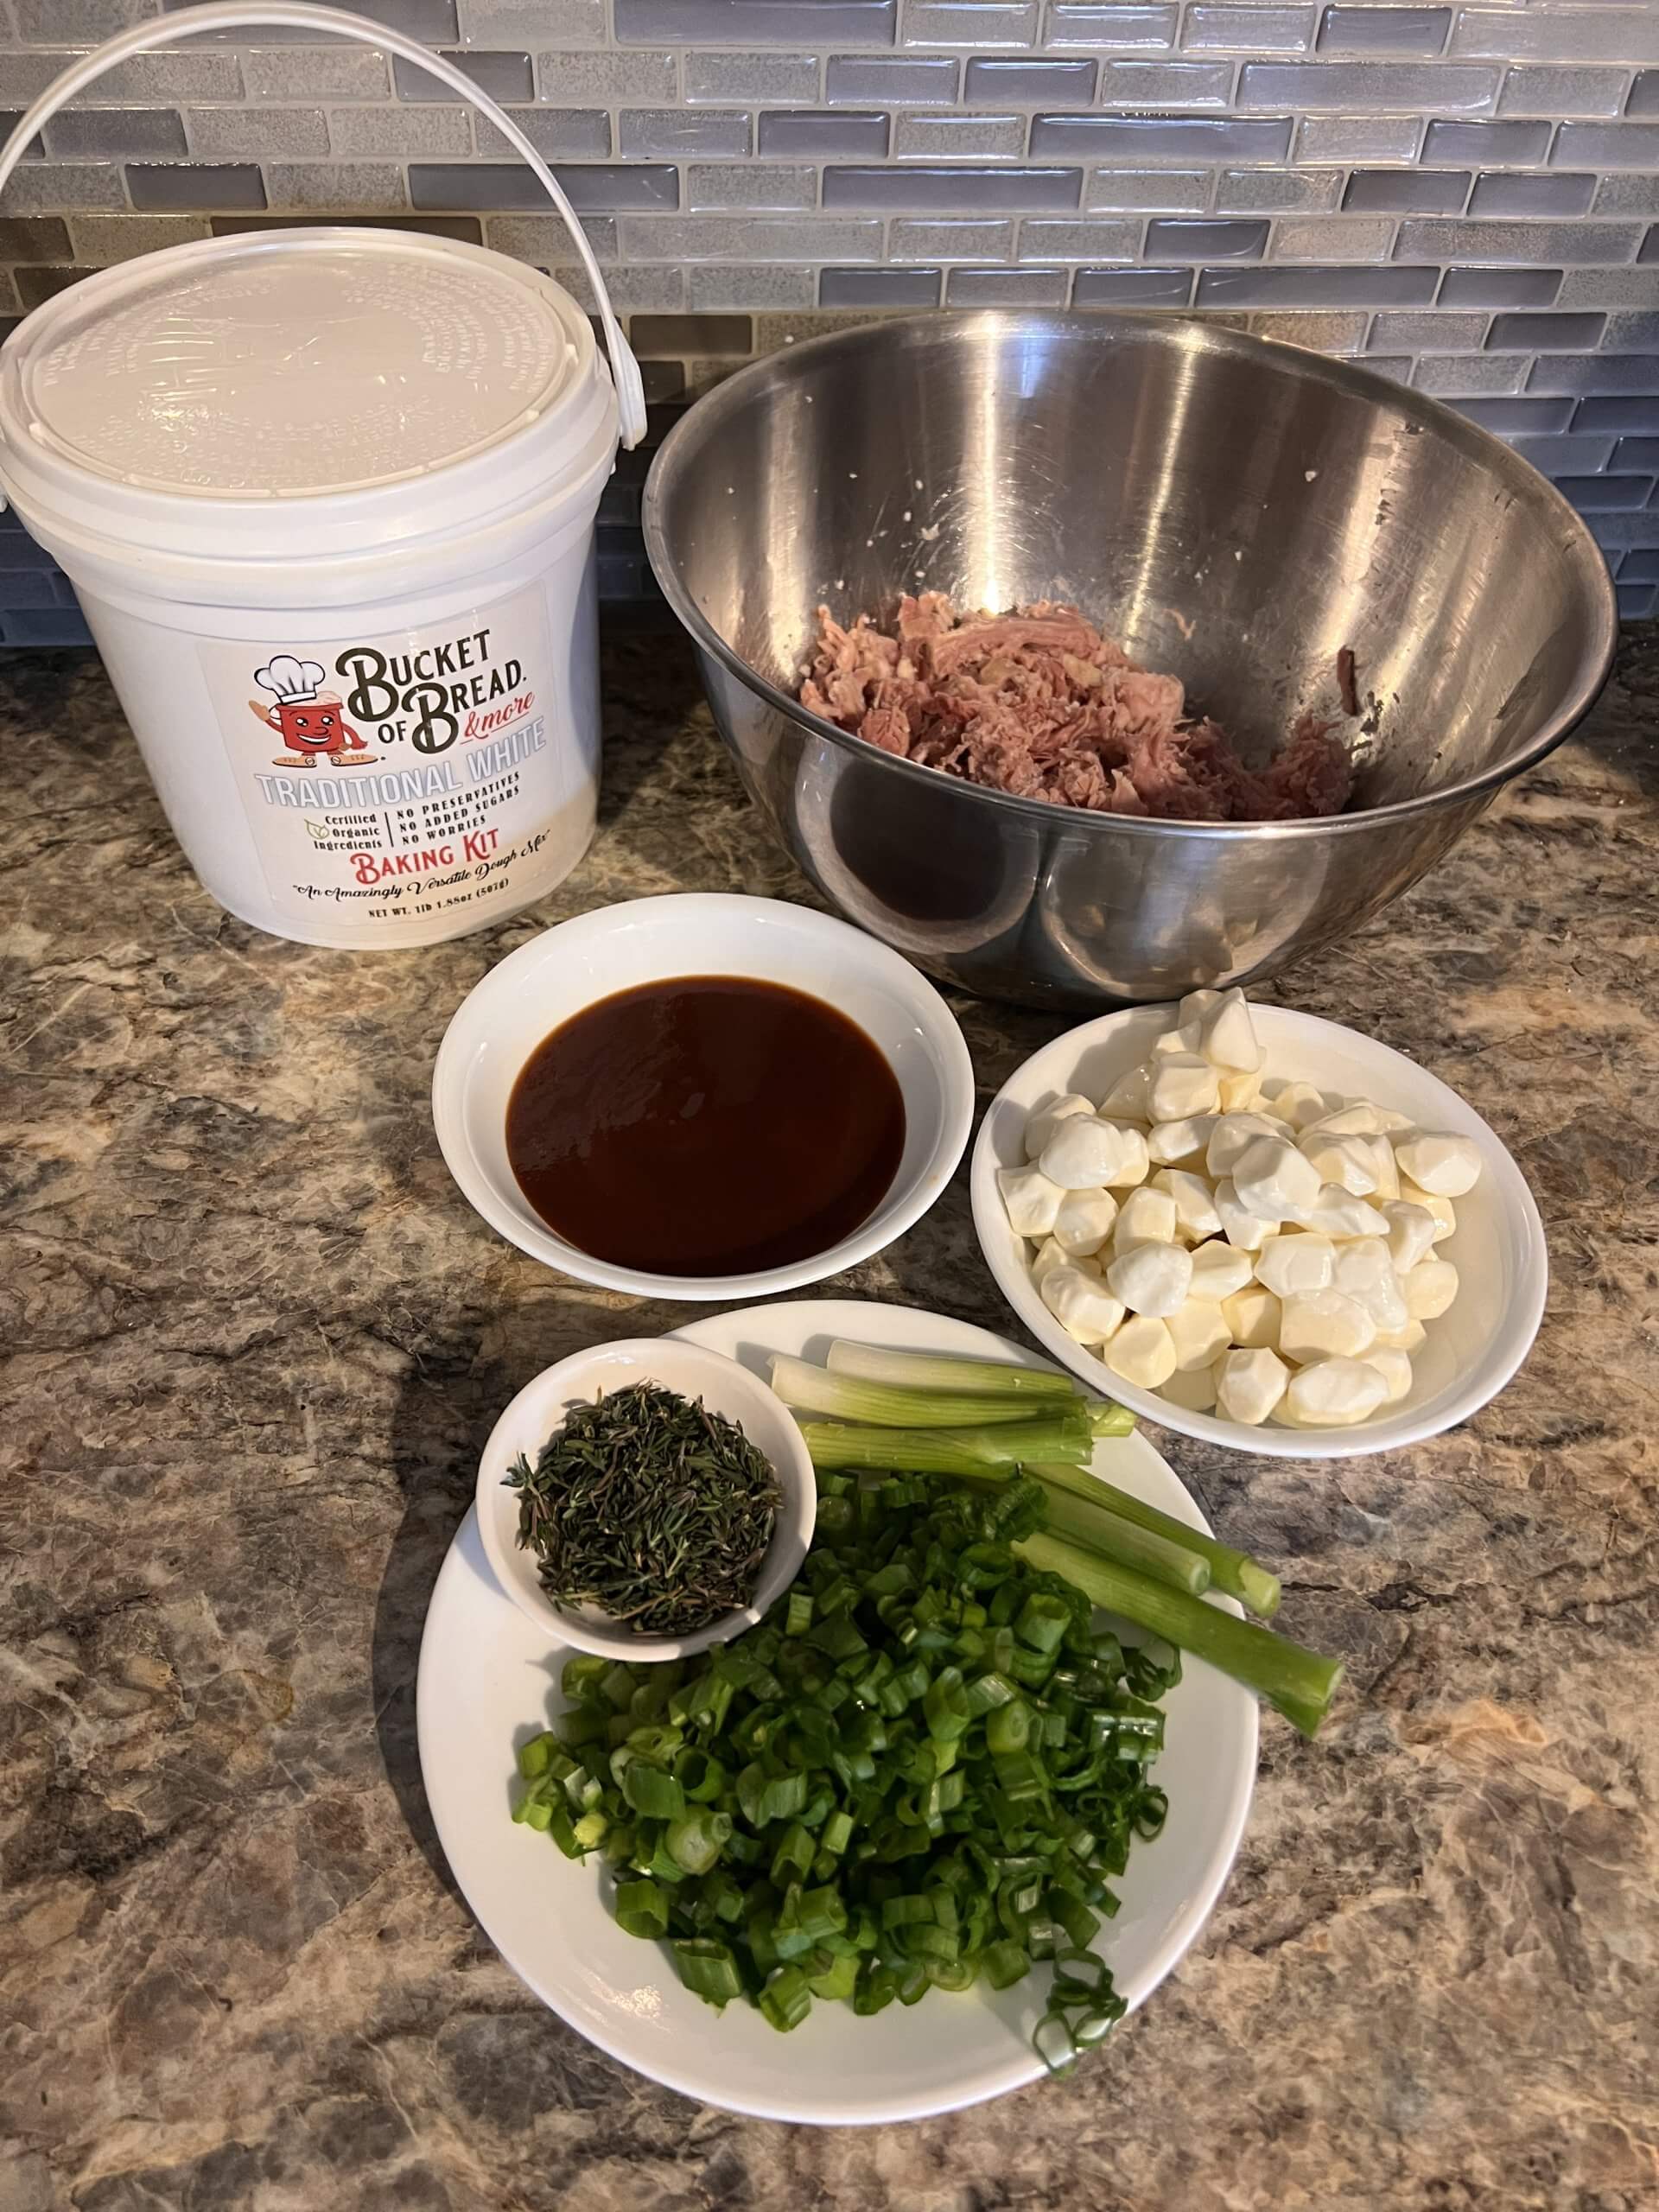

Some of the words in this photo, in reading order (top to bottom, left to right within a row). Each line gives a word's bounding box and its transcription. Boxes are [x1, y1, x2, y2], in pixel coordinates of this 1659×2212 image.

[335, 629, 490, 722] BUCKET
[378, 721, 407, 744] OF
[253, 760, 463, 809] TRADITIONAL
[466, 715, 546, 783] WHITE
[397, 808, 414, 820] NO
[422, 771, 519, 815] PRESERVATIVES
[399, 822, 416, 833] NO
[424, 808, 468, 828] ADDED
[475, 785, 519, 812] SUGARS
[325, 814, 377, 825] Certified
[333, 827, 380, 838] Organic
[402, 835, 419, 845] NO
[427, 815, 486, 841] WORRIES
[314, 839, 382, 851] Ingredients
[349, 845, 454, 885] BAKING
[463, 828, 499, 862] KIT
[325, 884, 404, 902] Amazingly
[407, 869, 472, 894] Versatile
[475, 849, 517, 880] Dough
[369, 909, 387, 918] NET
[392, 907, 411, 917] WT.
[436, 893, 473, 909] 1.88oz
